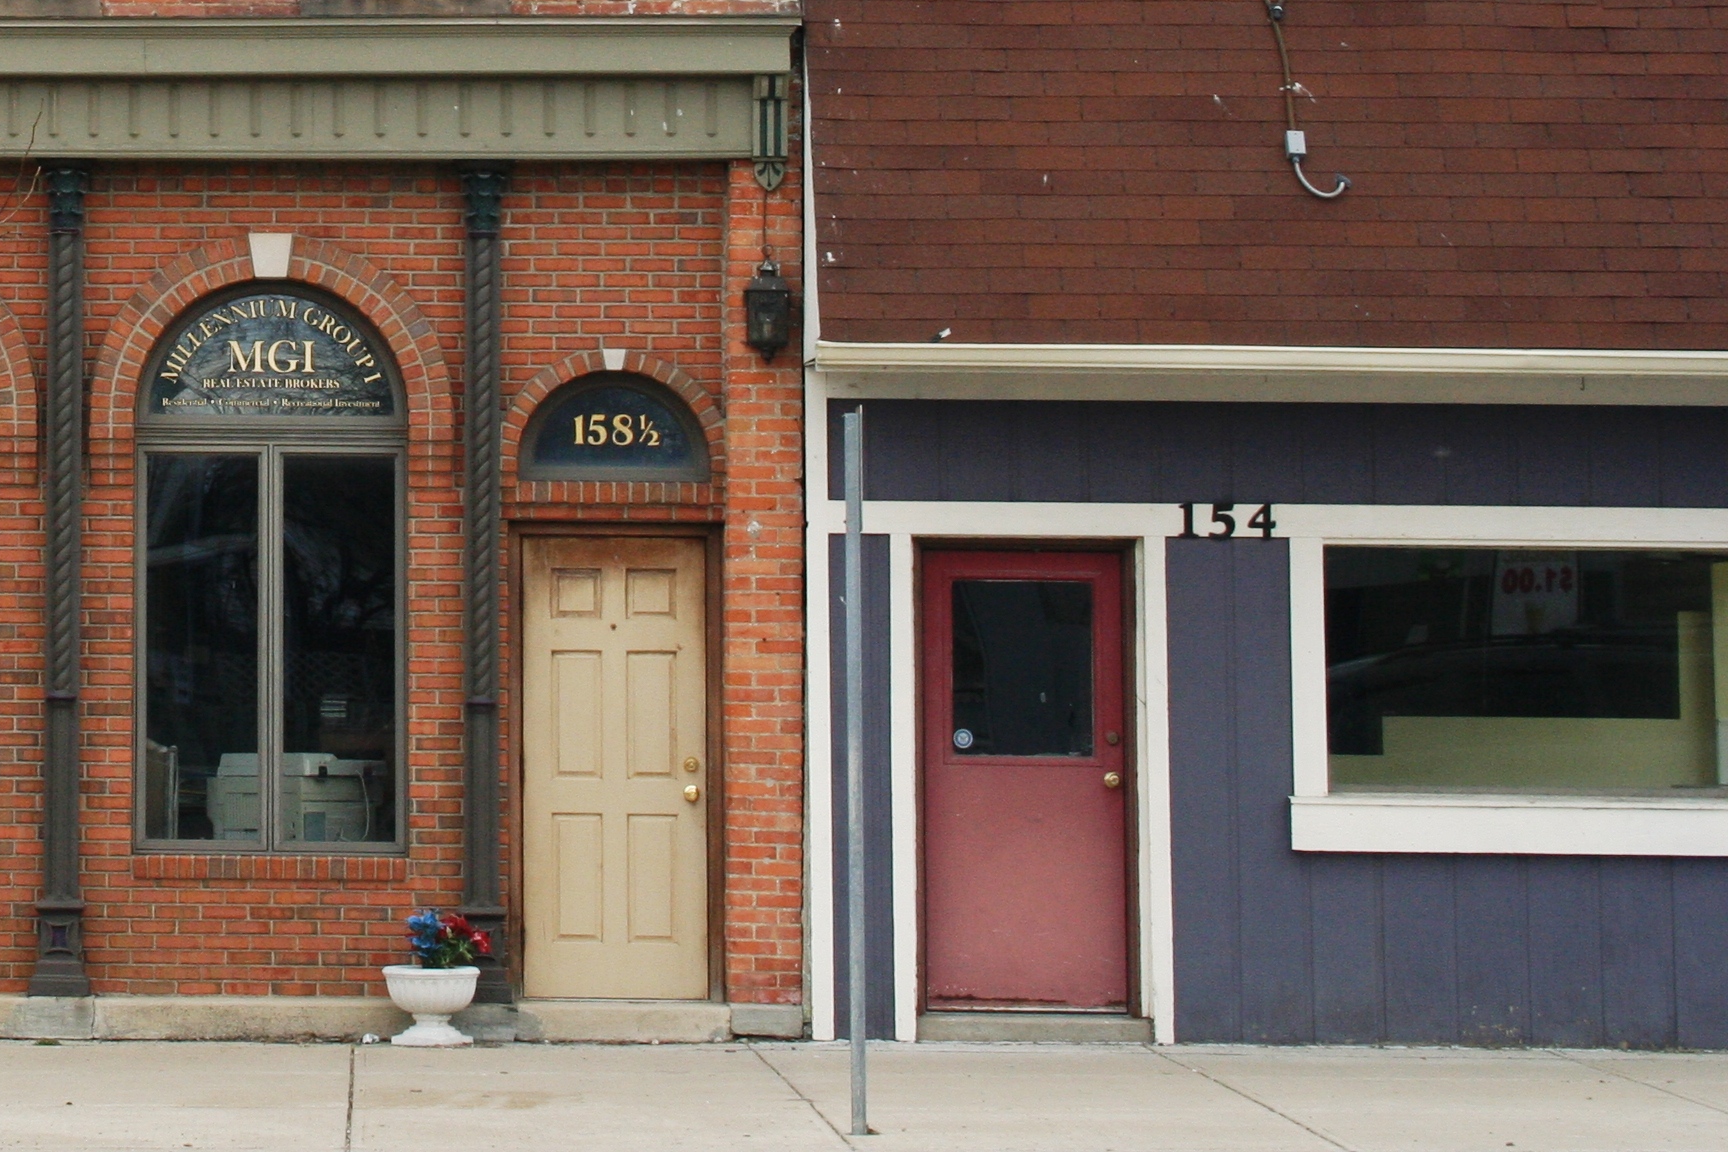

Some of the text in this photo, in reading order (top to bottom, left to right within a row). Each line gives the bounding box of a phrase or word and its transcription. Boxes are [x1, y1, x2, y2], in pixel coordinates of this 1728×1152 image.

[160, 299, 382, 385] MILLENNIUM GROUP I
[227, 340, 316, 373] MGI
[202, 378, 340, 389] REAL ESTATE BROKERS
[1178, 501, 1277, 541] 154
